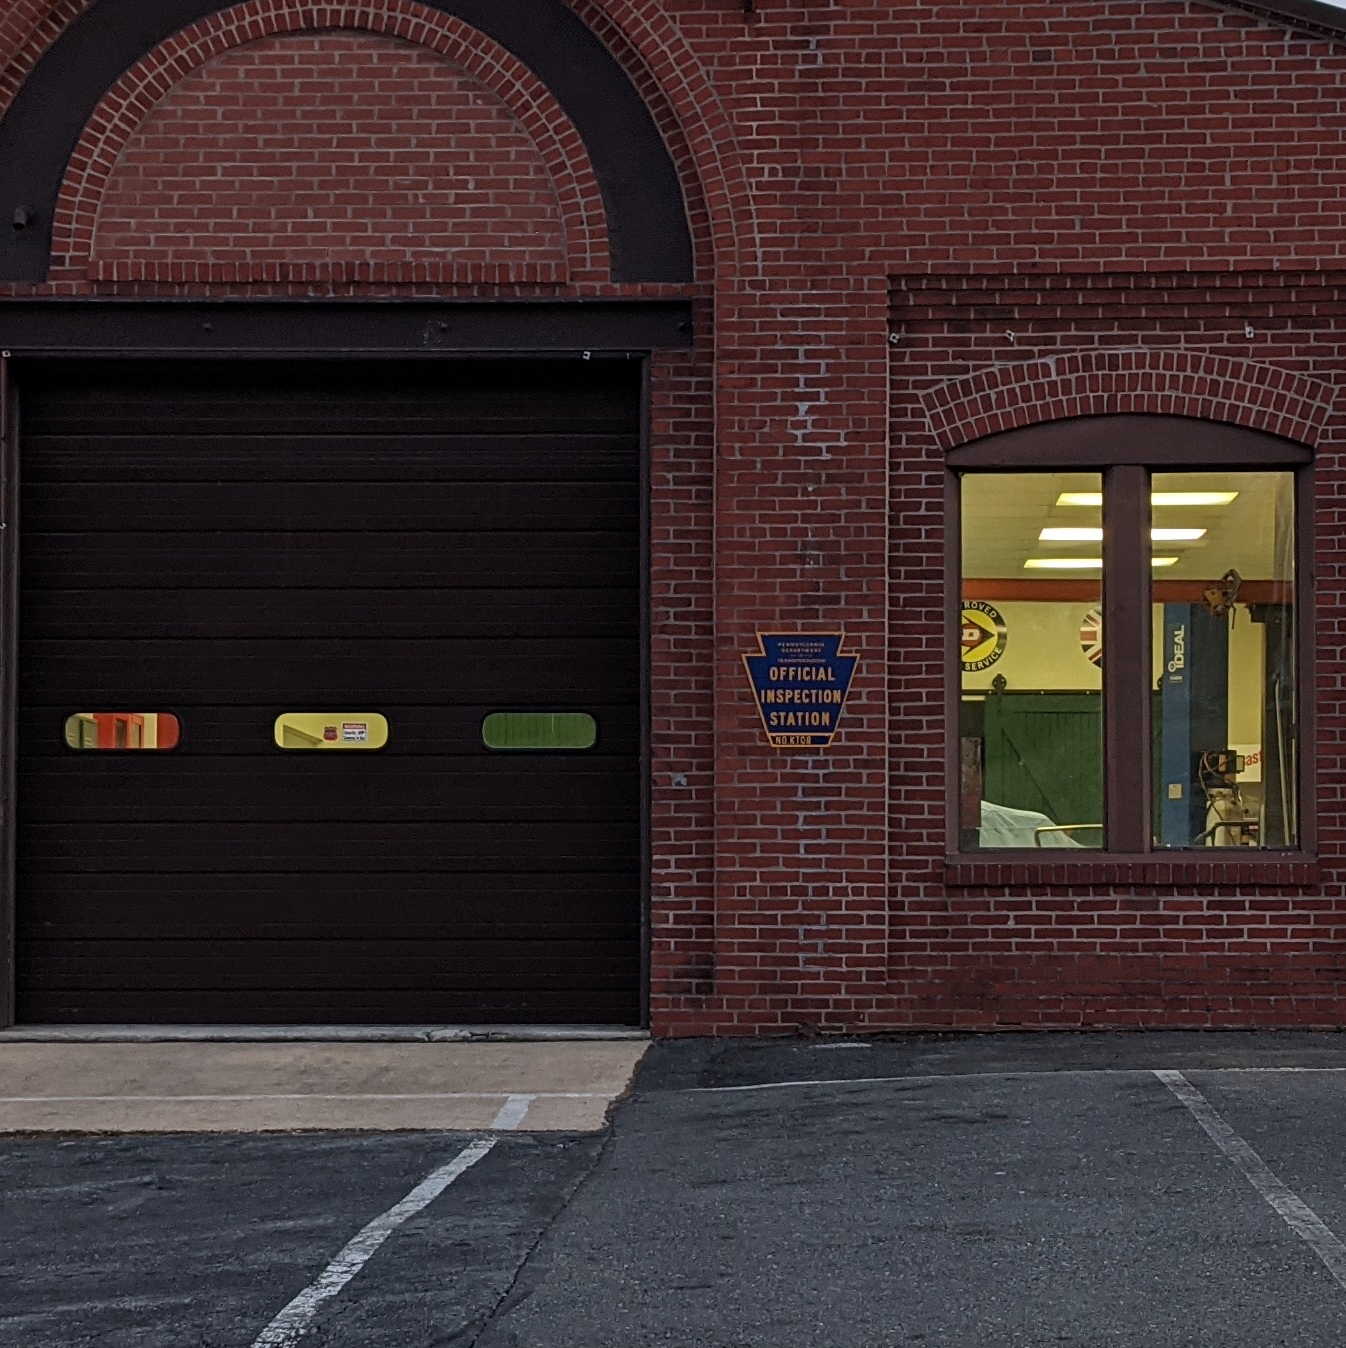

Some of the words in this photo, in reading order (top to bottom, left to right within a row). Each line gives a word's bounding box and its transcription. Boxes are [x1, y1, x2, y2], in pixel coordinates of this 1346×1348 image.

[963, 601, 997, 618] ROVED
[964, 647, 1003, 671] SERVICE
[769, 667, 835, 681] OFFICIAL
[760, 689, 841, 703] INSPECTION
[769, 712, 830, 726] STATION
